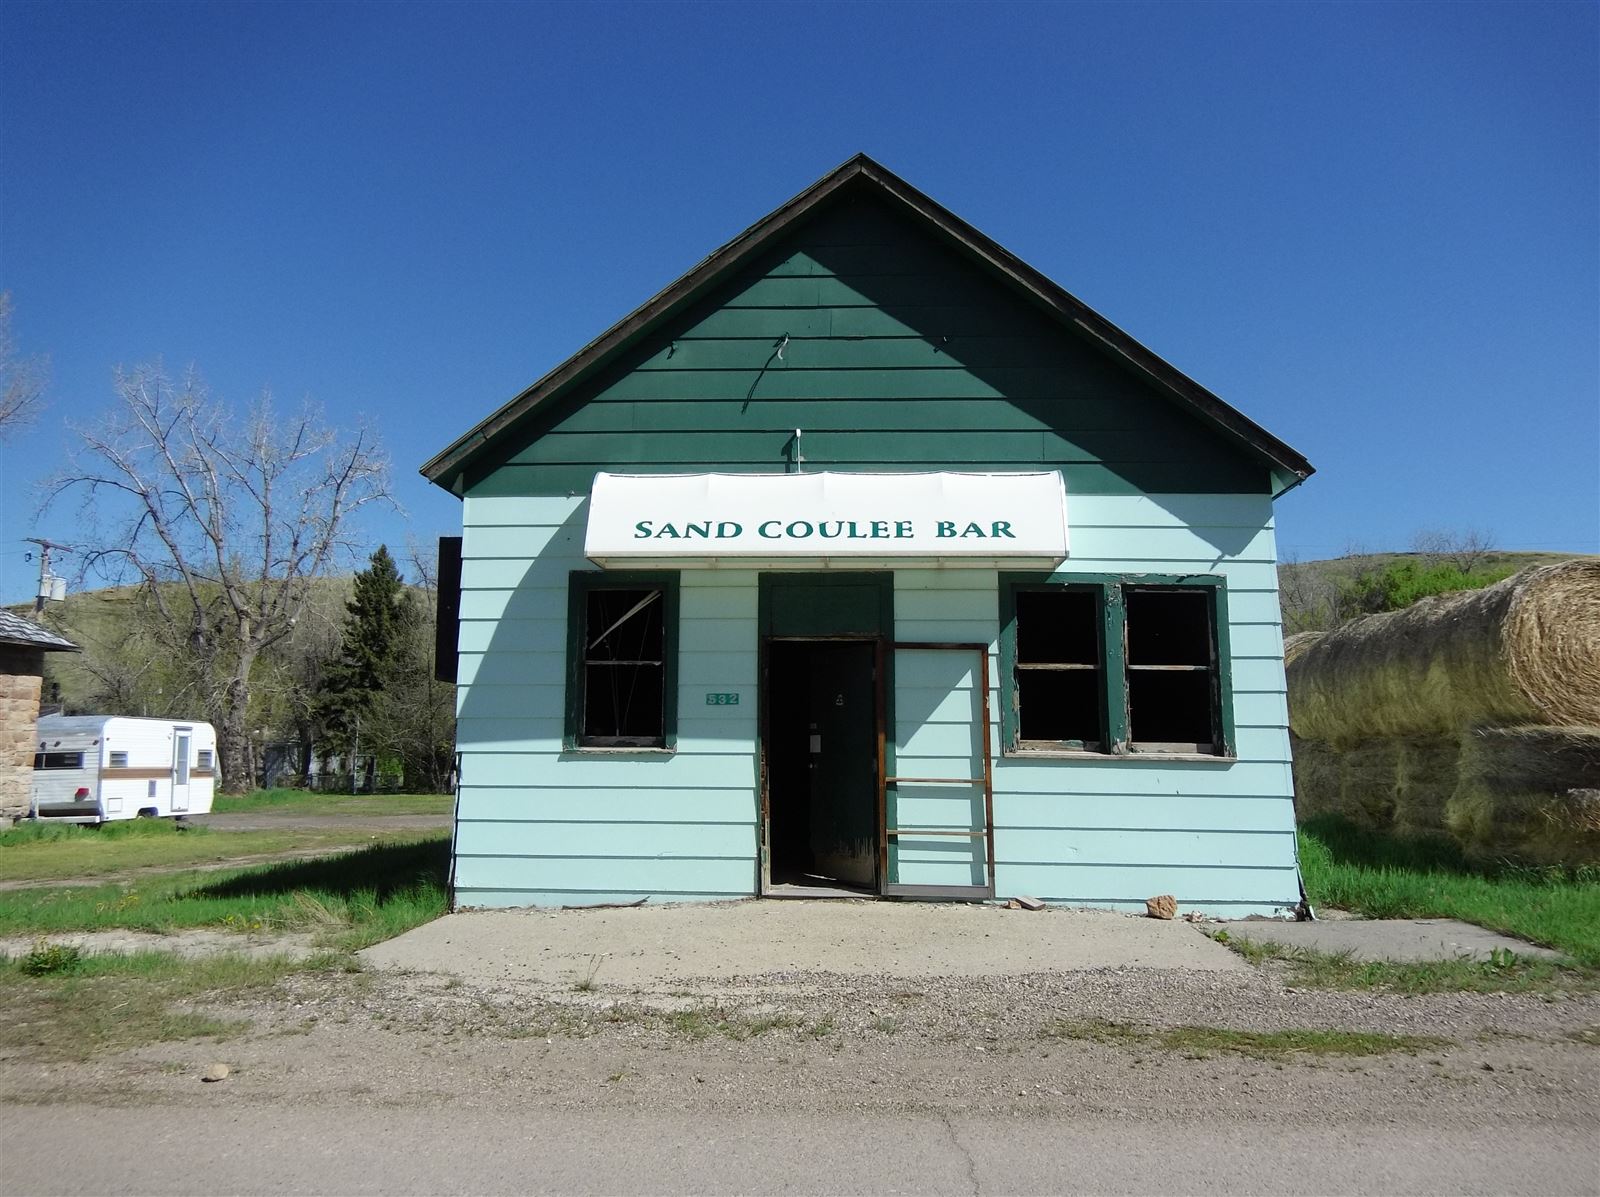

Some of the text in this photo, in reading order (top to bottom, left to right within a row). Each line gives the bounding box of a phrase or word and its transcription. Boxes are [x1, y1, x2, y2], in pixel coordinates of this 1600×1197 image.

[634, 520, 1017, 539] SAND COULEE BAR
[707, 693, 738, 705] 532
